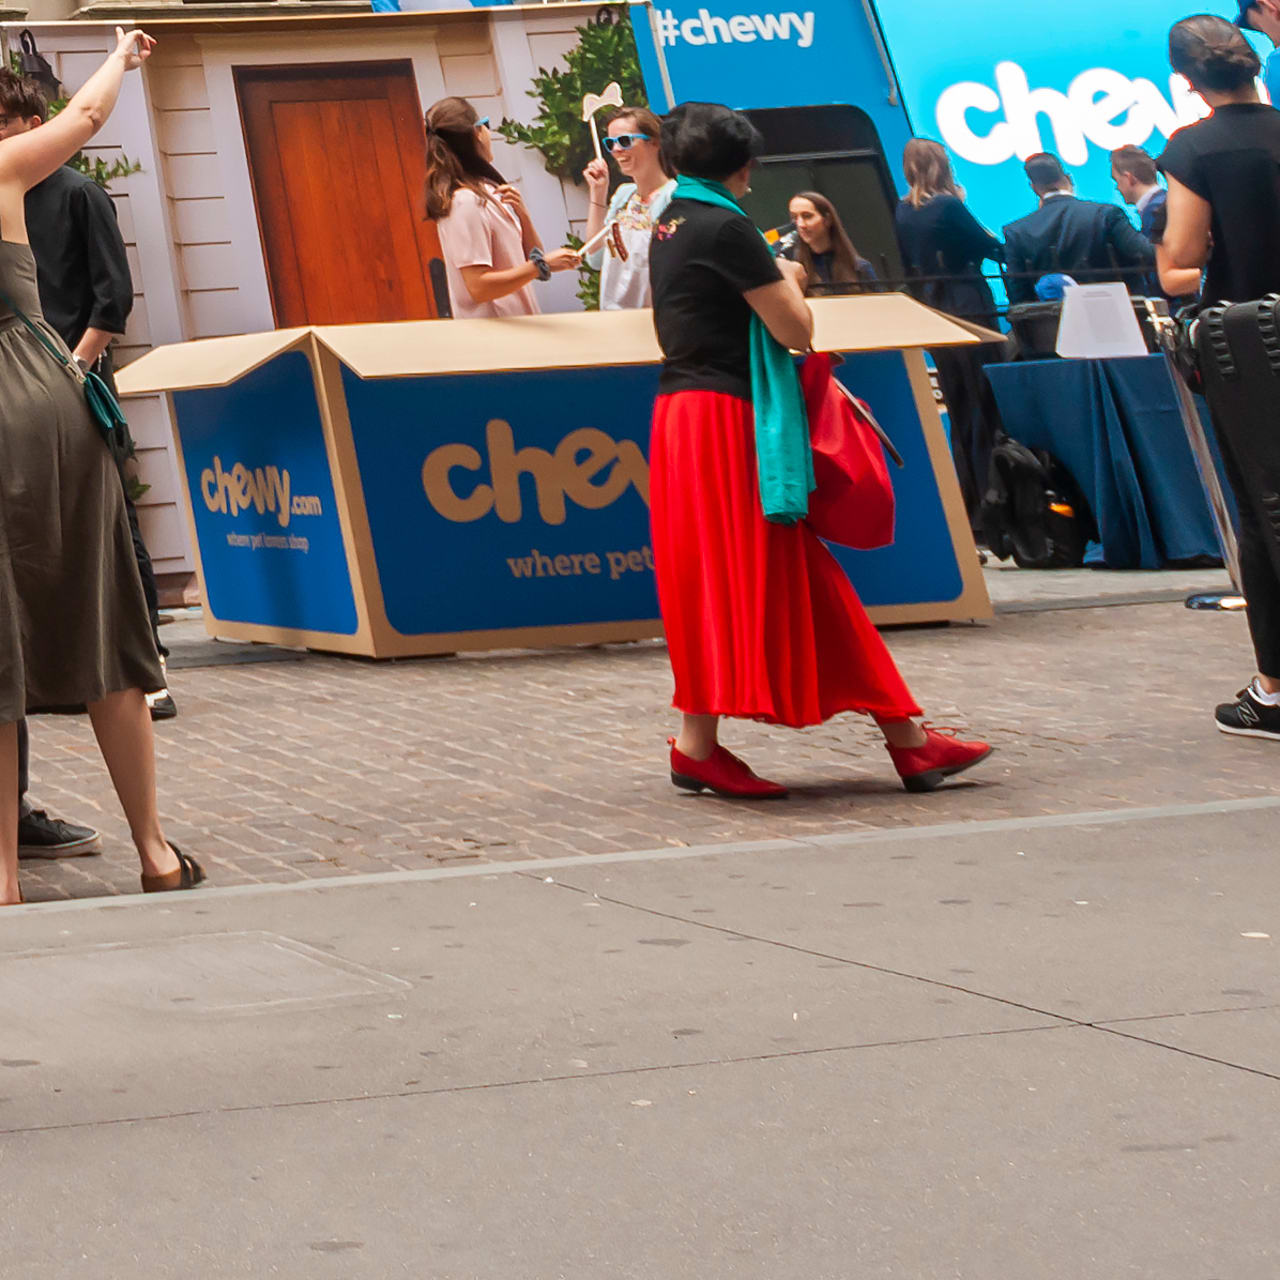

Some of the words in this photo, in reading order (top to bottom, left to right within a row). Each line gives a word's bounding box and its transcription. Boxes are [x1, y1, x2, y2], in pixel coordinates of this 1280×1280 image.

[656, 8, 815, 48] #chewy
[506, 549, 602, 579] where
[605, 545, 656, 581] pet
